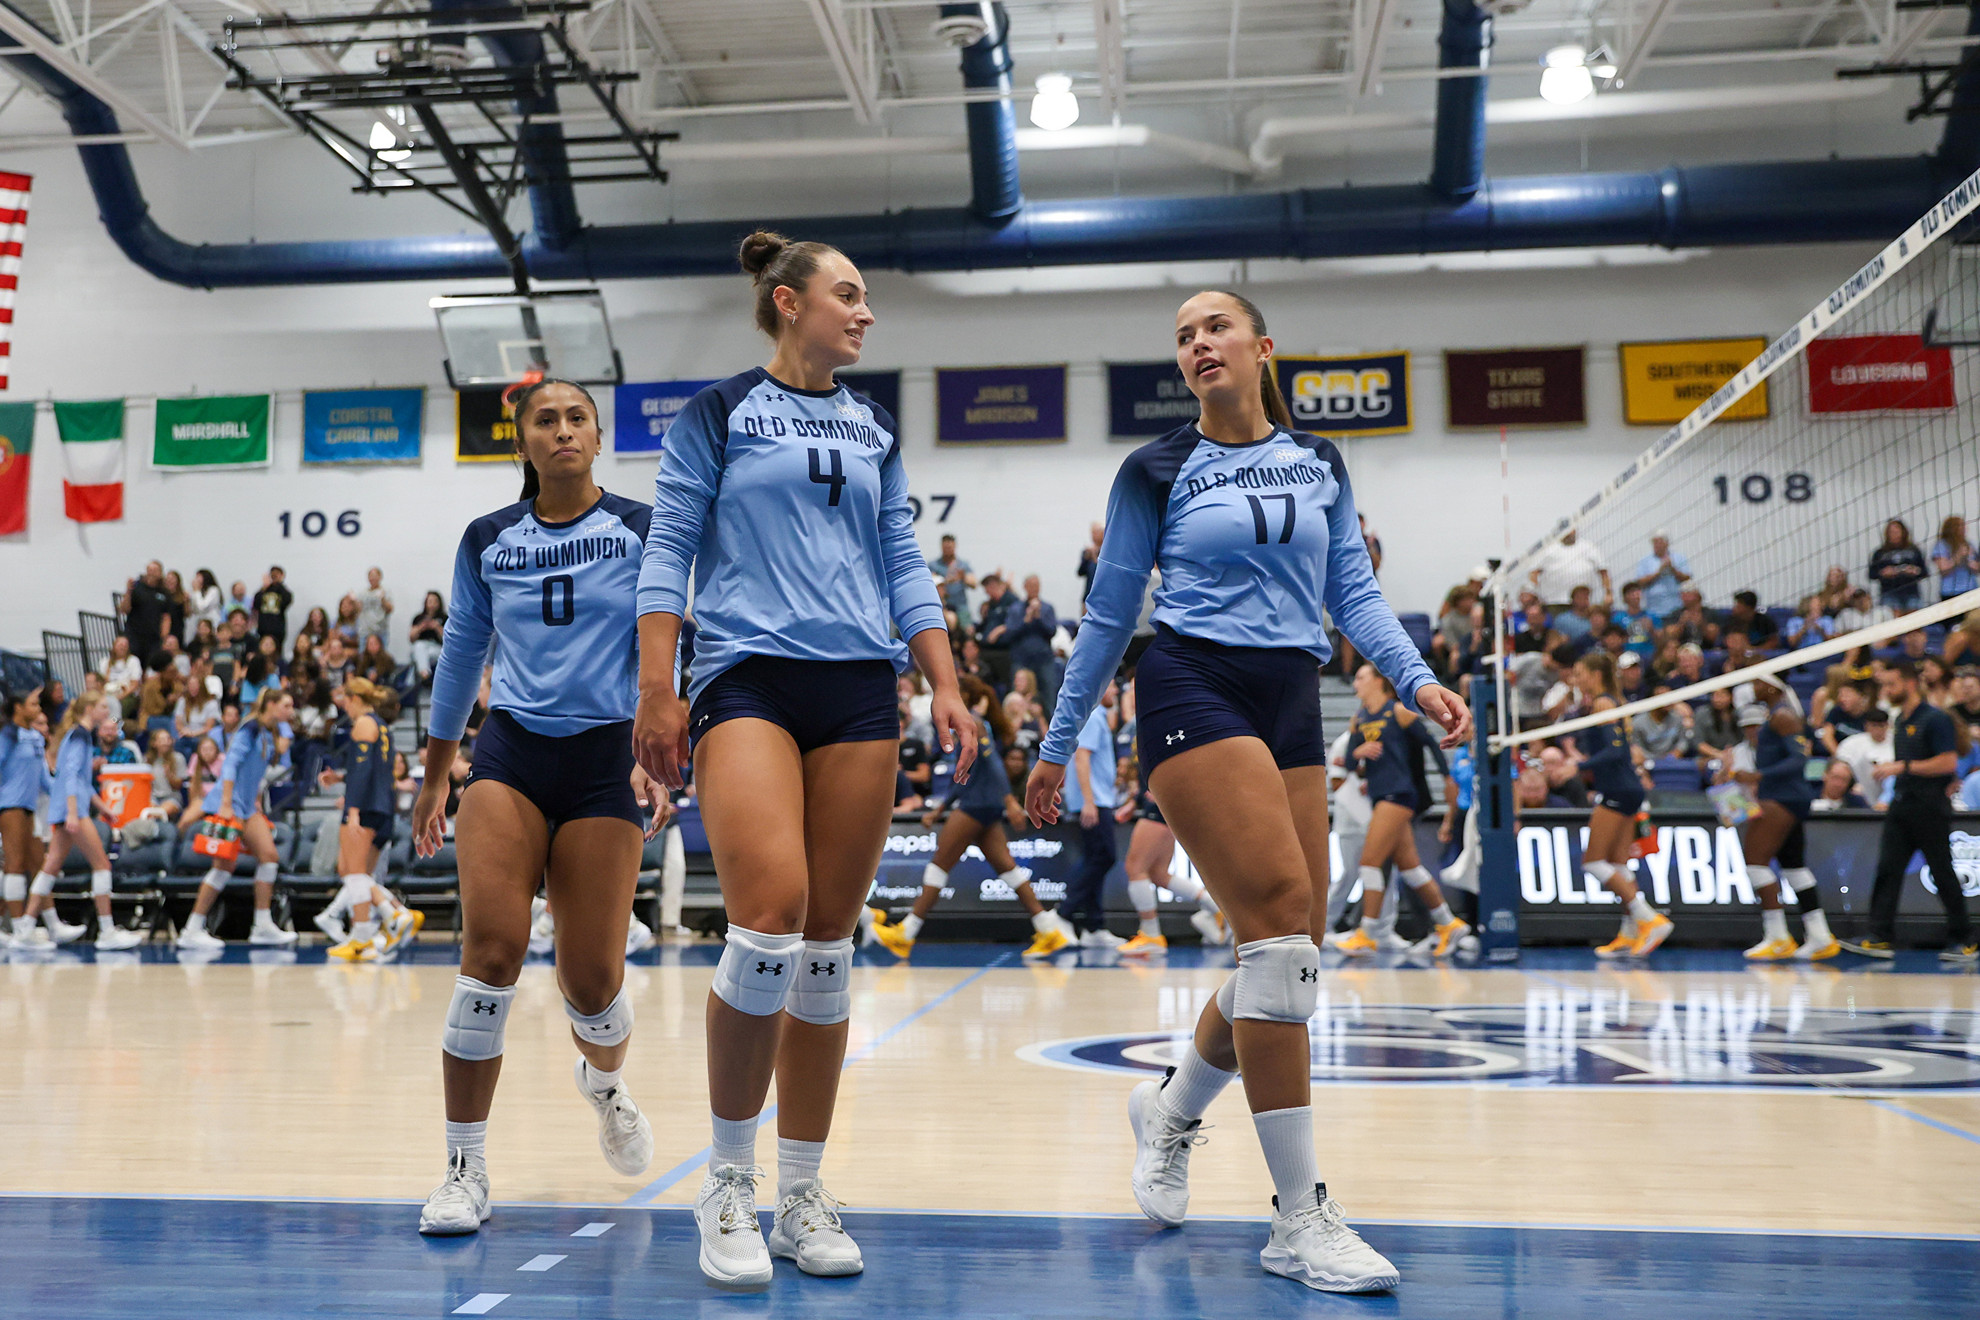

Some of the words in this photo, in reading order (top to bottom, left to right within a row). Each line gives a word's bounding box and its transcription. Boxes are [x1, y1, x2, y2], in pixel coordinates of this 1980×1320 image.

[1921, 210, 1940, 238] OLD
[1488, 367, 1545, 387] TEXAS
[1830, 362, 1928, 385] LOUISIANA
[1292, 369, 1392, 420] SBC
[1487, 387, 1543, 409] STATE
[329, 407, 395, 425] COASTAL
[172, 421, 250, 441] MARSHALL
[325, 427, 399, 444] CAROLINA
[744, 415, 787, 438] OLD
[792, 417, 885, 450] DOMINION
[807, 447, 847, 507] 4
[1187, 472, 1228, 498] OLD
[1234, 463, 1326, 489] DOMINION
[1713, 474, 1812, 504] 108
[279, 509, 362, 538] 106
[1244, 493, 1297, 545] 17
[494, 546, 527, 572] OLD
[535, 536, 627, 569] DOMINION
[541, 573, 575, 627] 0
